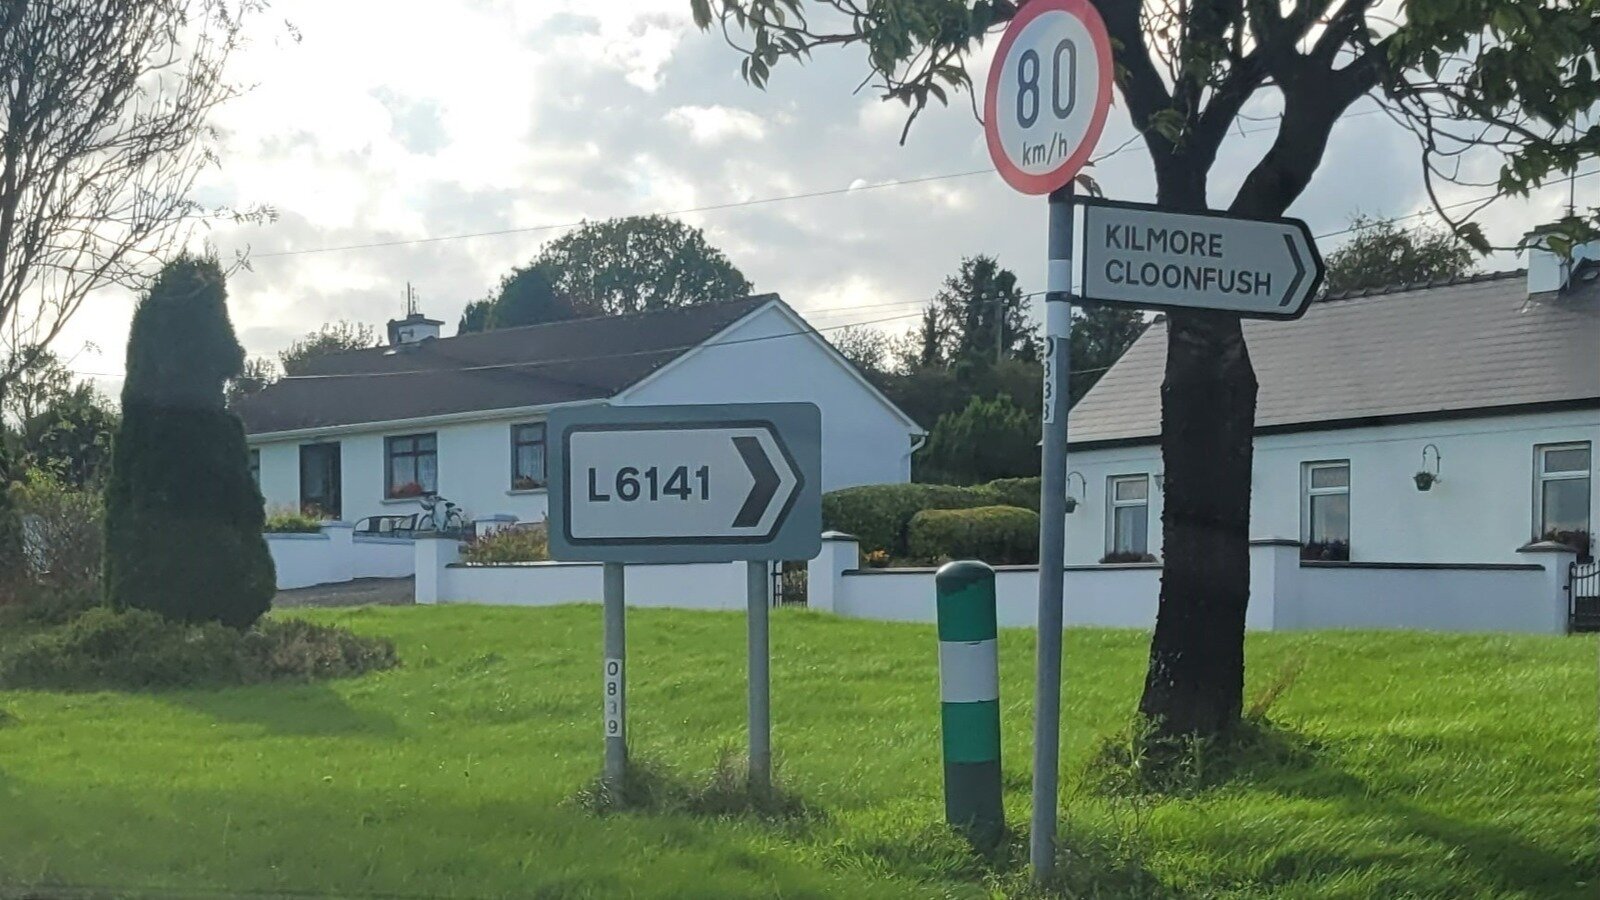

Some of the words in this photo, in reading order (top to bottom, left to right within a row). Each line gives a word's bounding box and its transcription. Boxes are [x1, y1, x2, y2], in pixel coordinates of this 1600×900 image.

[1017, 39, 1076, 128] 80
[1022, 132, 1067, 166] km/h
[1106, 224, 1223, 258] KILMORE
[1105, 259, 1271, 296] CLOONFUSH
[588, 465, 709, 502] L6141
